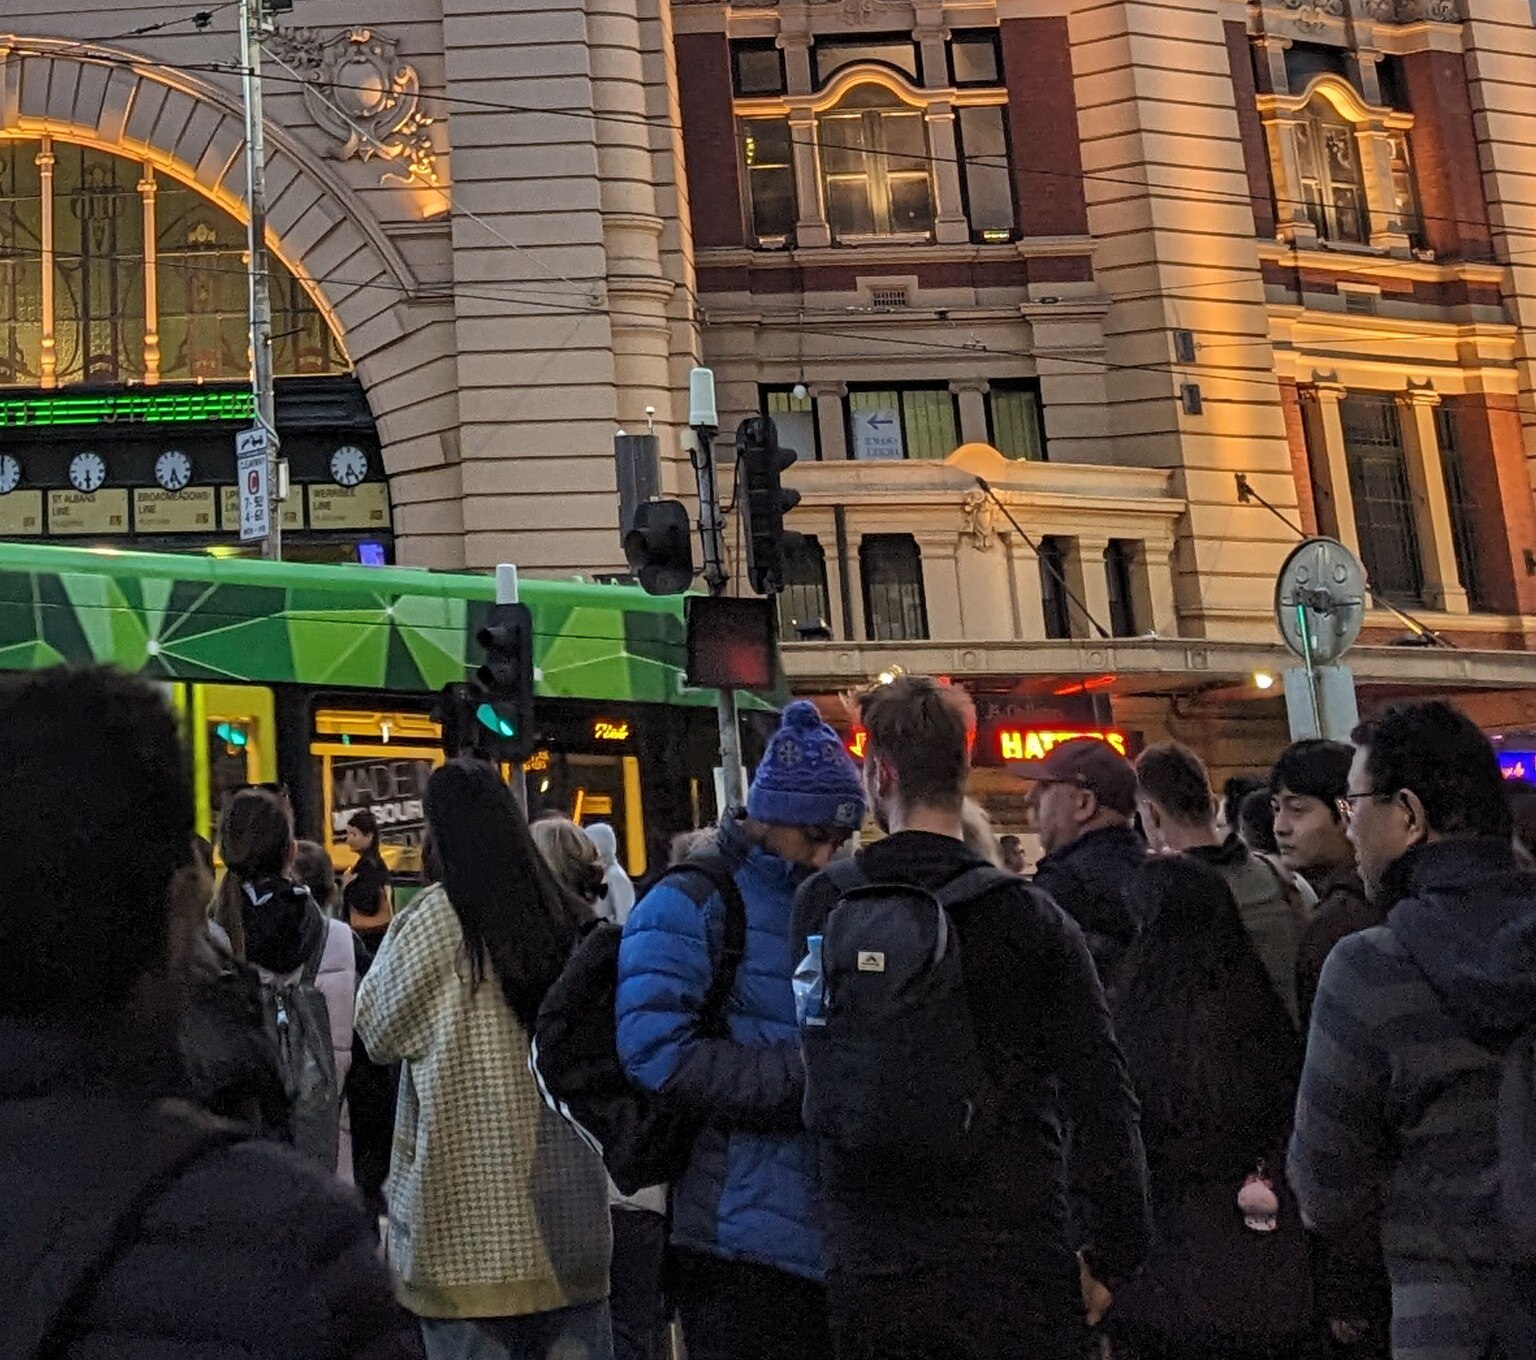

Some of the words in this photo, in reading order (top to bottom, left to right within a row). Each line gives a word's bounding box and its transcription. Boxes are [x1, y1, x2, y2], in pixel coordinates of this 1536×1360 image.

[103, 394, 253, 423] STATION
[64, 493, 96, 503] ALBANS
[138, 491, 208, 502] BROADMEADOWS
[52, 506, 69, 516] LINE
[139, 504, 156, 514] LINE
[313, 501, 331, 511] LINE
